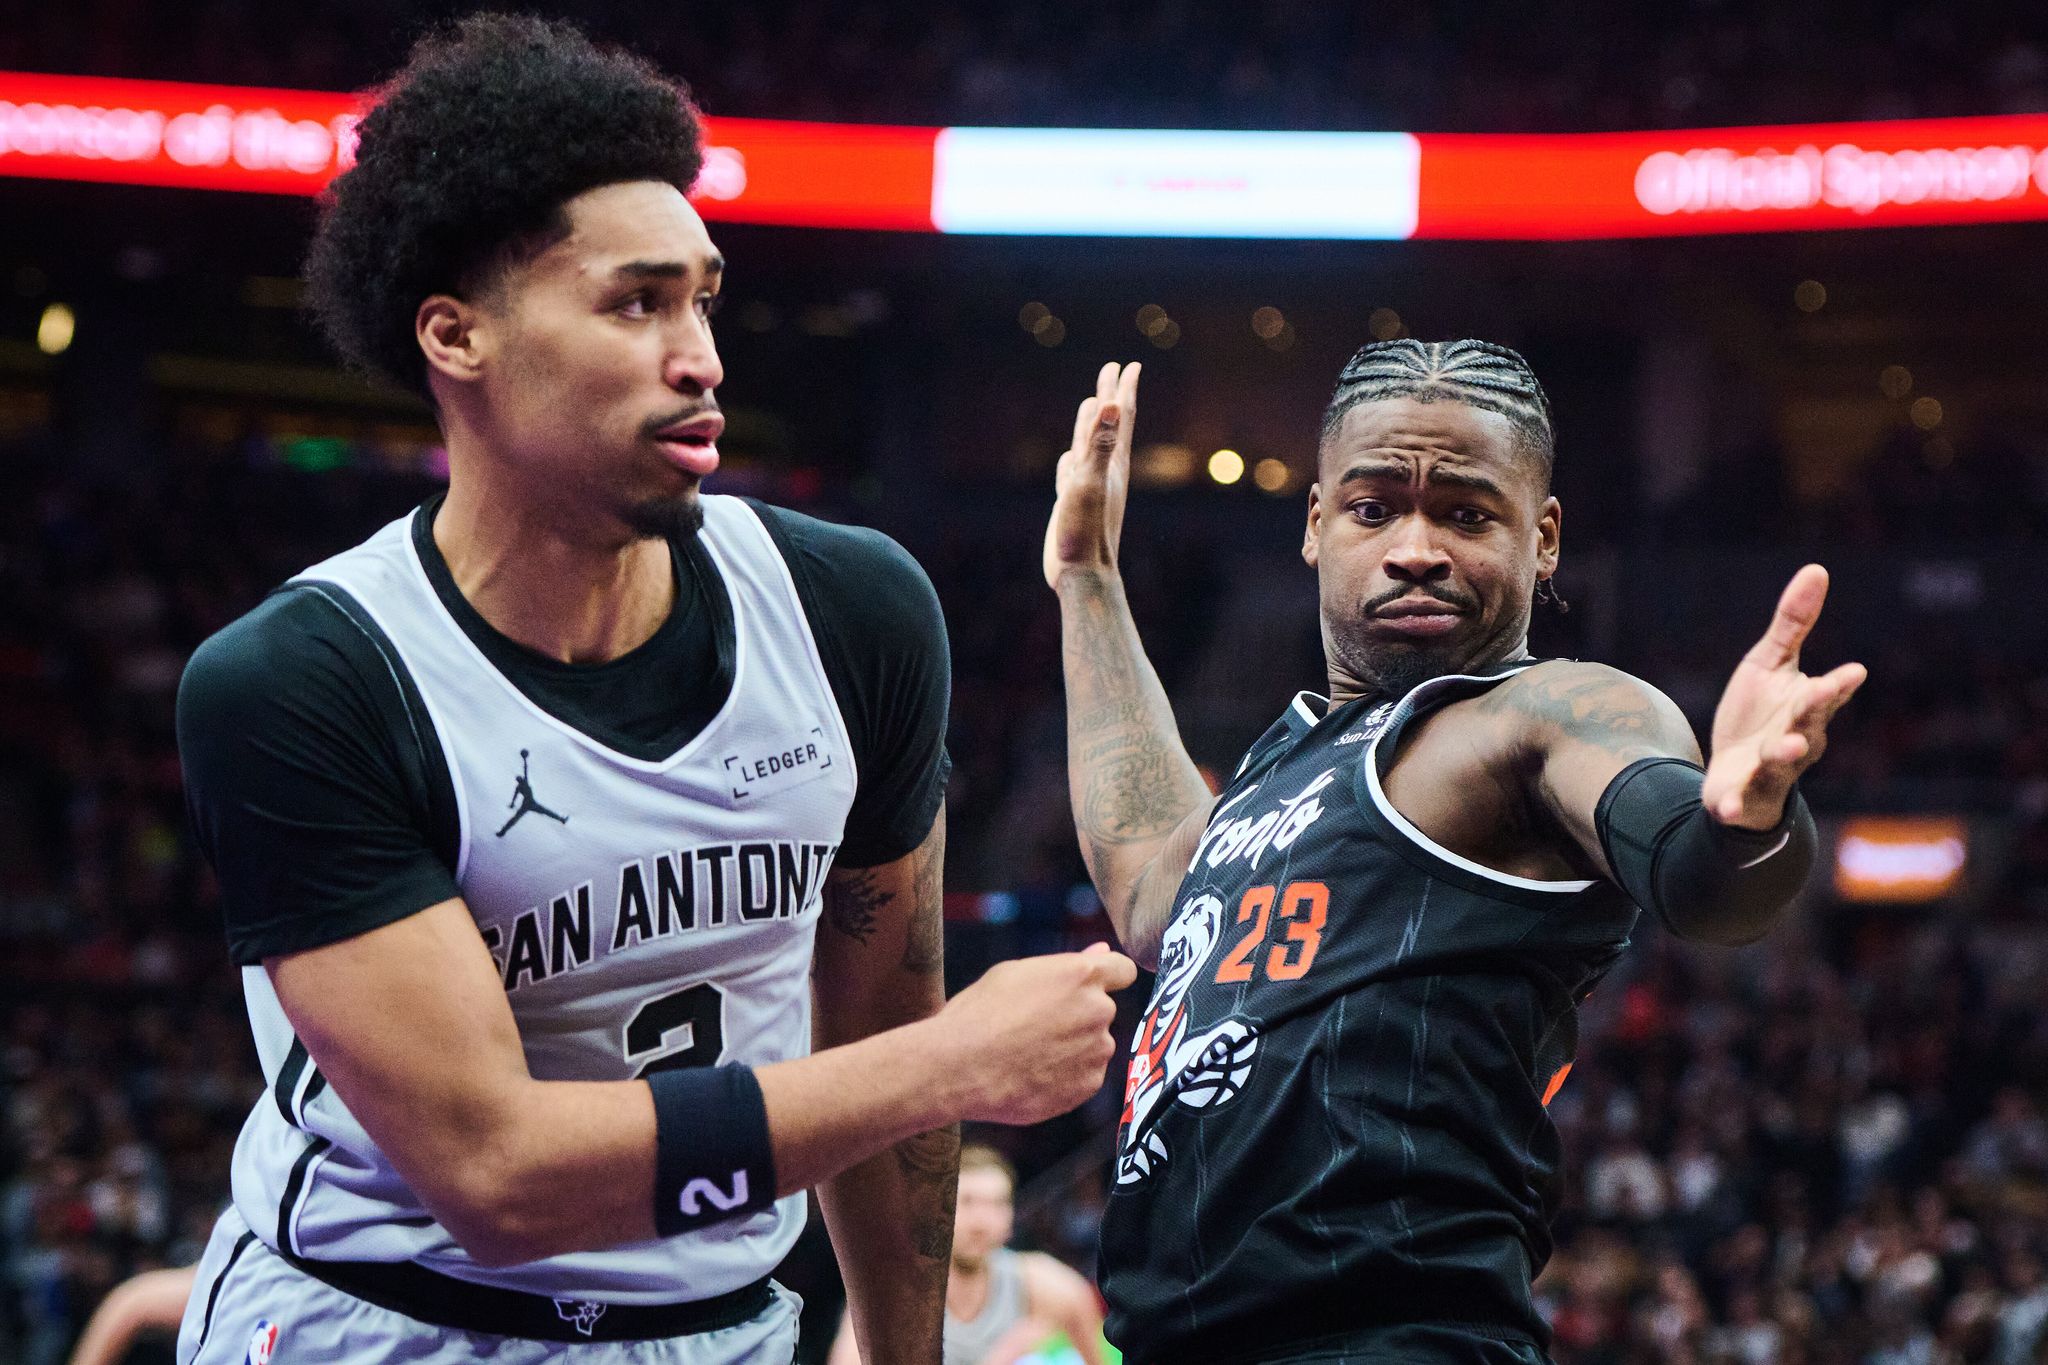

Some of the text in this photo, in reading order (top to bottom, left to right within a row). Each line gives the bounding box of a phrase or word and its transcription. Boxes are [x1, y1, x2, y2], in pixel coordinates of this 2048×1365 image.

[741, 743, 818, 783] LEDGER
[610, 840, 840, 953] ANTONI
[1213, 879, 1330, 984] 23
[679, 1168, 749, 1216] 2
